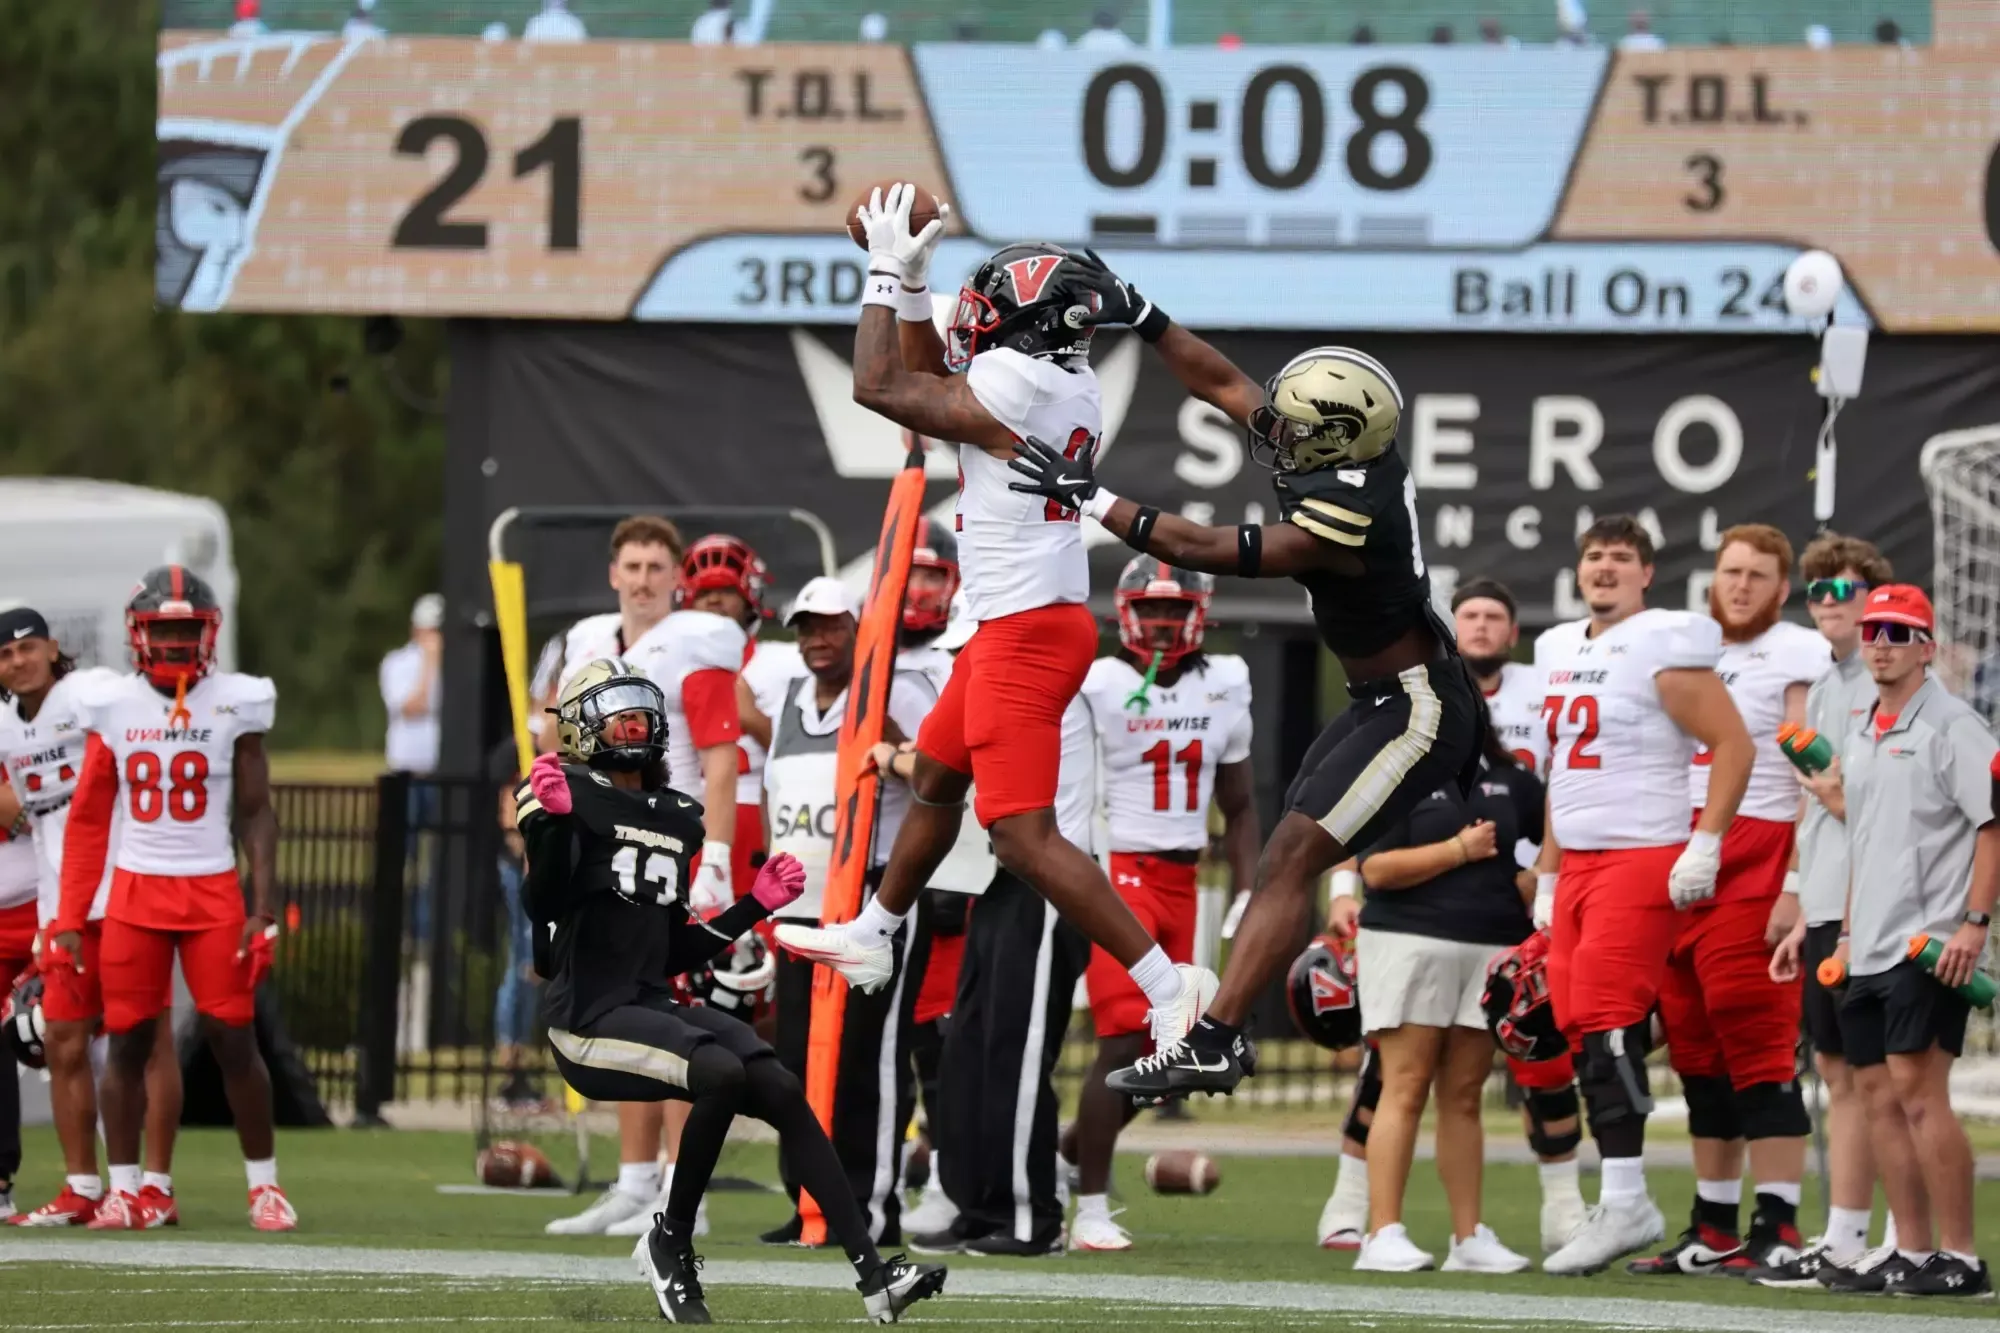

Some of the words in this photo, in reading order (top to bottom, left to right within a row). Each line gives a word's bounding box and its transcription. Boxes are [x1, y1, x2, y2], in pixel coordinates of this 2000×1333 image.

[1082, 63, 1434, 191] 0:08
[390, 113, 582, 252] 21
[798, 147, 837, 203] 3
[1683, 154, 1726, 212] 3
[737, 257, 863, 305] 3RD
[1454, 267, 1575, 317] Ball
[1604, 269, 1688, 317] On
[1174, 393, 1745, 494] SERO
[125, 727, 213, 743] UVAWISE
[1126, 716, 1211, 733] UVAWISE
[1540, 694, 1602, 770] 72
[125, 750, 210, 823] 88
[1140, 739, 1204, 813] 11
[775, 803, 837, 839] SAC
